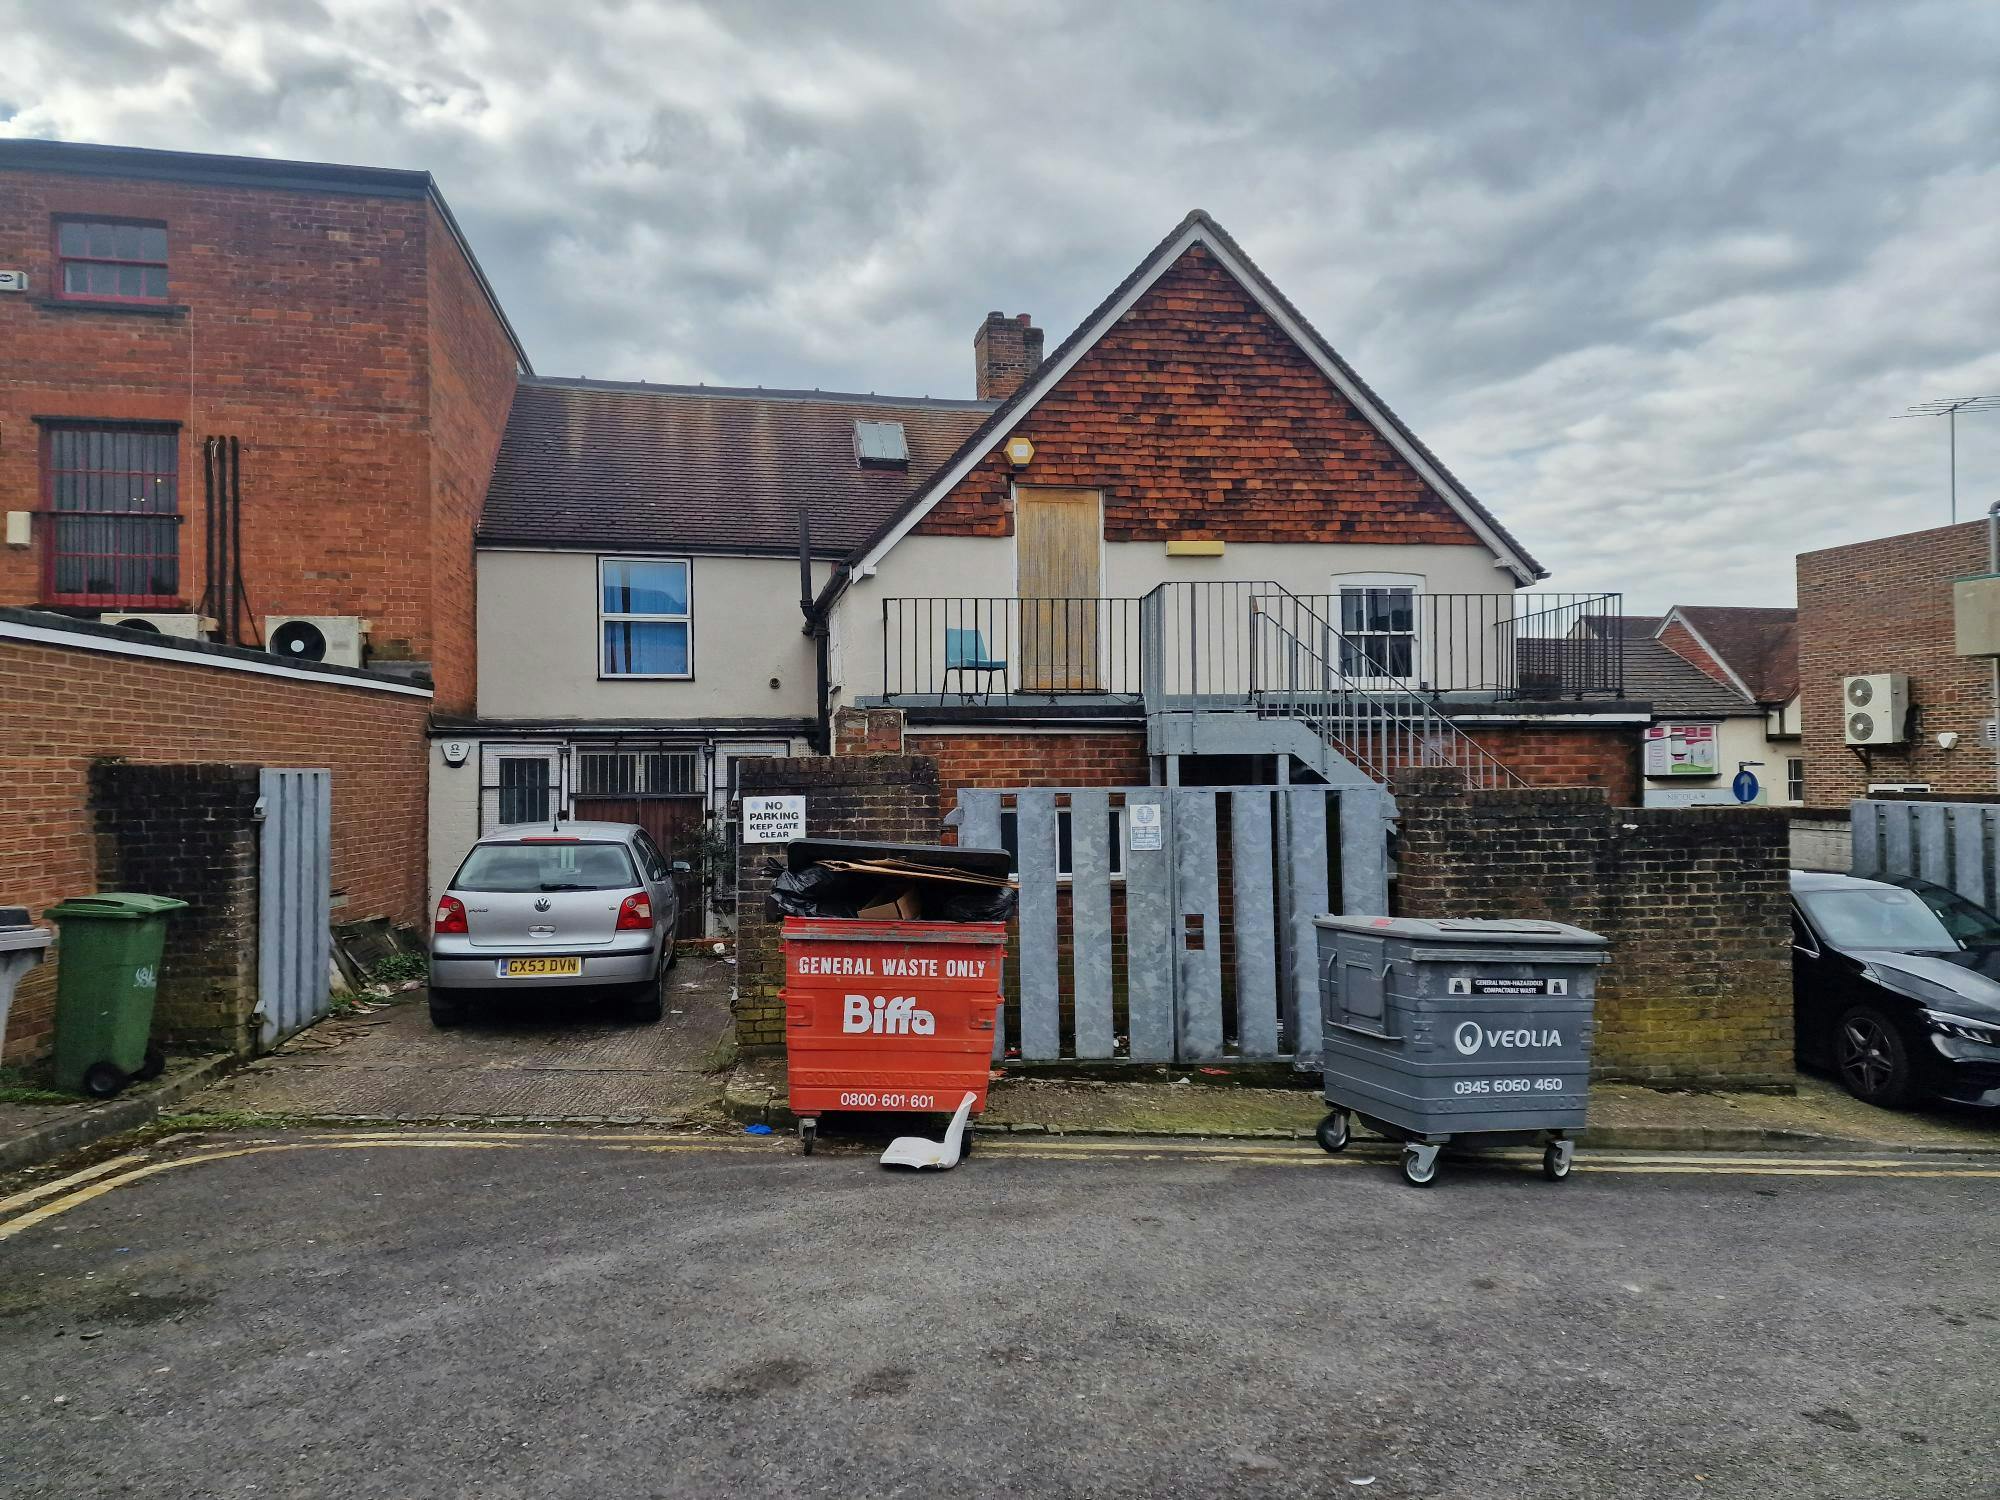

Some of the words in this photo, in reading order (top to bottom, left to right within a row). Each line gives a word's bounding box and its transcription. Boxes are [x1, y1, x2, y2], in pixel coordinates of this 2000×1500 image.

[765, 801, 783, 810] NO
[749, 812, 799, 821] PARKING
[749, 823, 773, 831] KEEP
[776, 822, 799, 830] GATE
[759, 831, 789, 839] CLEAR
[509, 960, 546, 972] GX53
[549, 959, 577, 972] DVN
[798, 956, 874, 975] GENERAL
[882, 958, 938, 977] WASTE
[946, 960, 986, 978] ONLY
[842, 994, 936, 1035] Biffa
[1486, 1029, 1562, 1048] VEOLIA
[1454, 1080, 1490, 1094] 0345
[1493, 1078, 1531, 1093] 6060
[1534, 1077, 1563, 1091] 460
